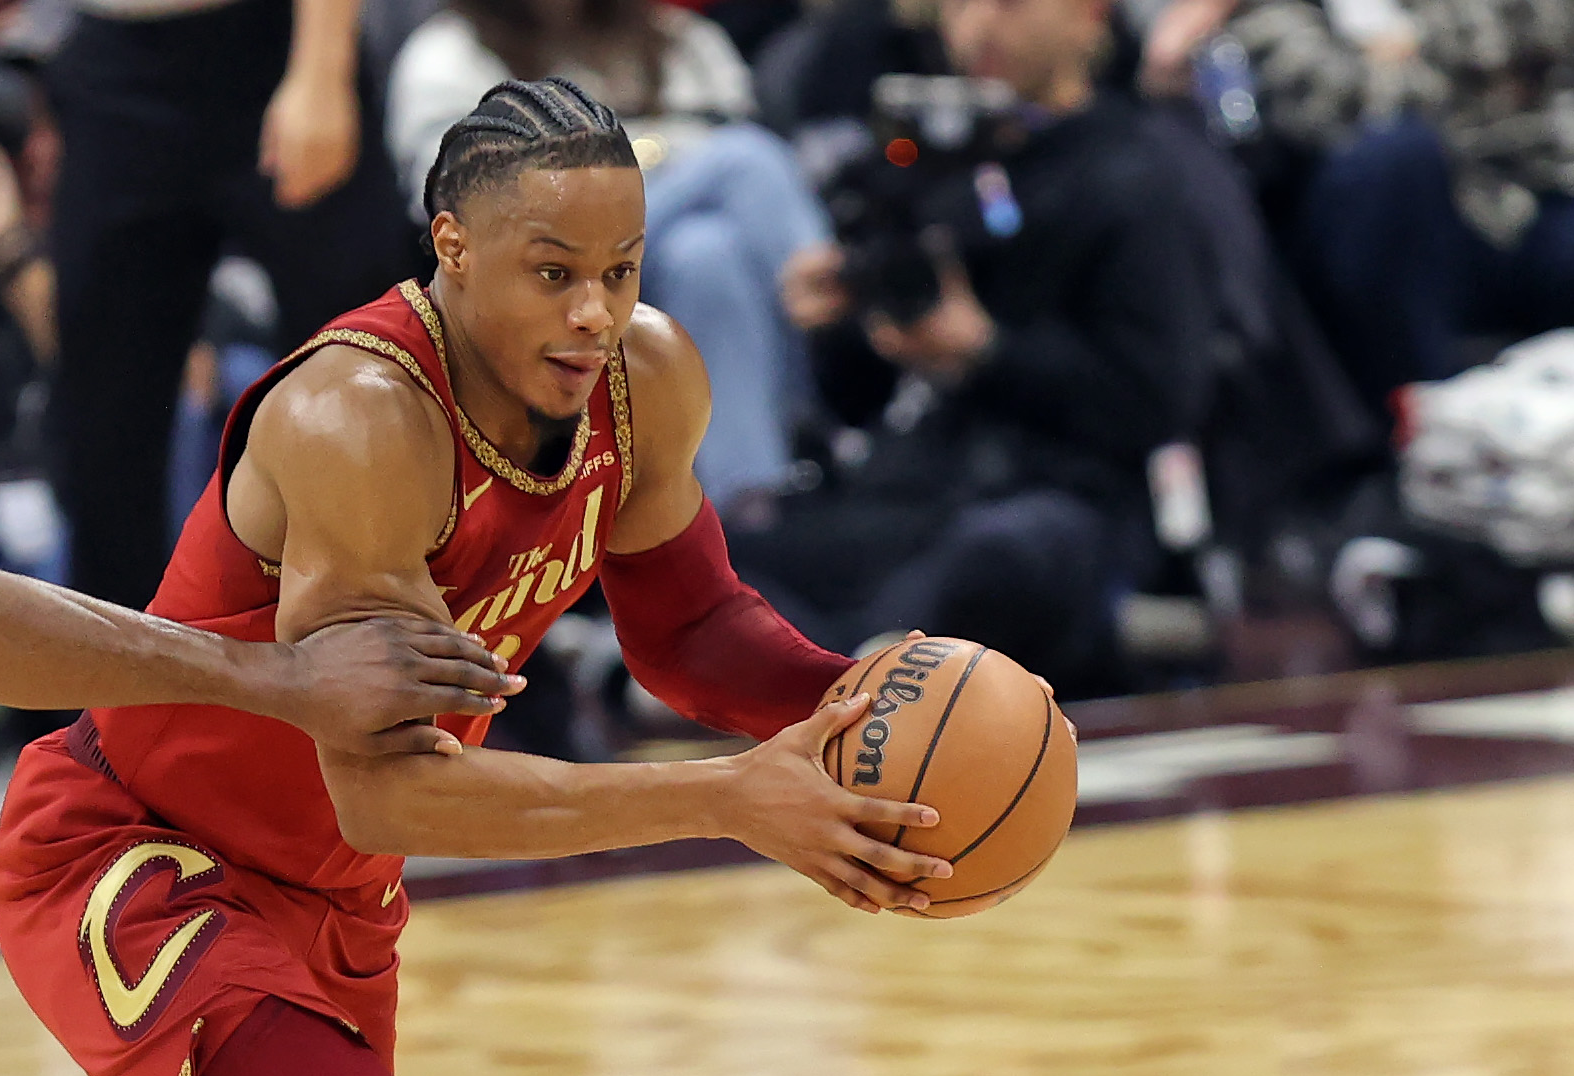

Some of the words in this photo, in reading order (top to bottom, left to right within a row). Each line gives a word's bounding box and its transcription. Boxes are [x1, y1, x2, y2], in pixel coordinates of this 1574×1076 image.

[579, 450, 615, 480] IFFS
[437, 485, 604, 632] and
[852, 640, 960, 787] Wilson
